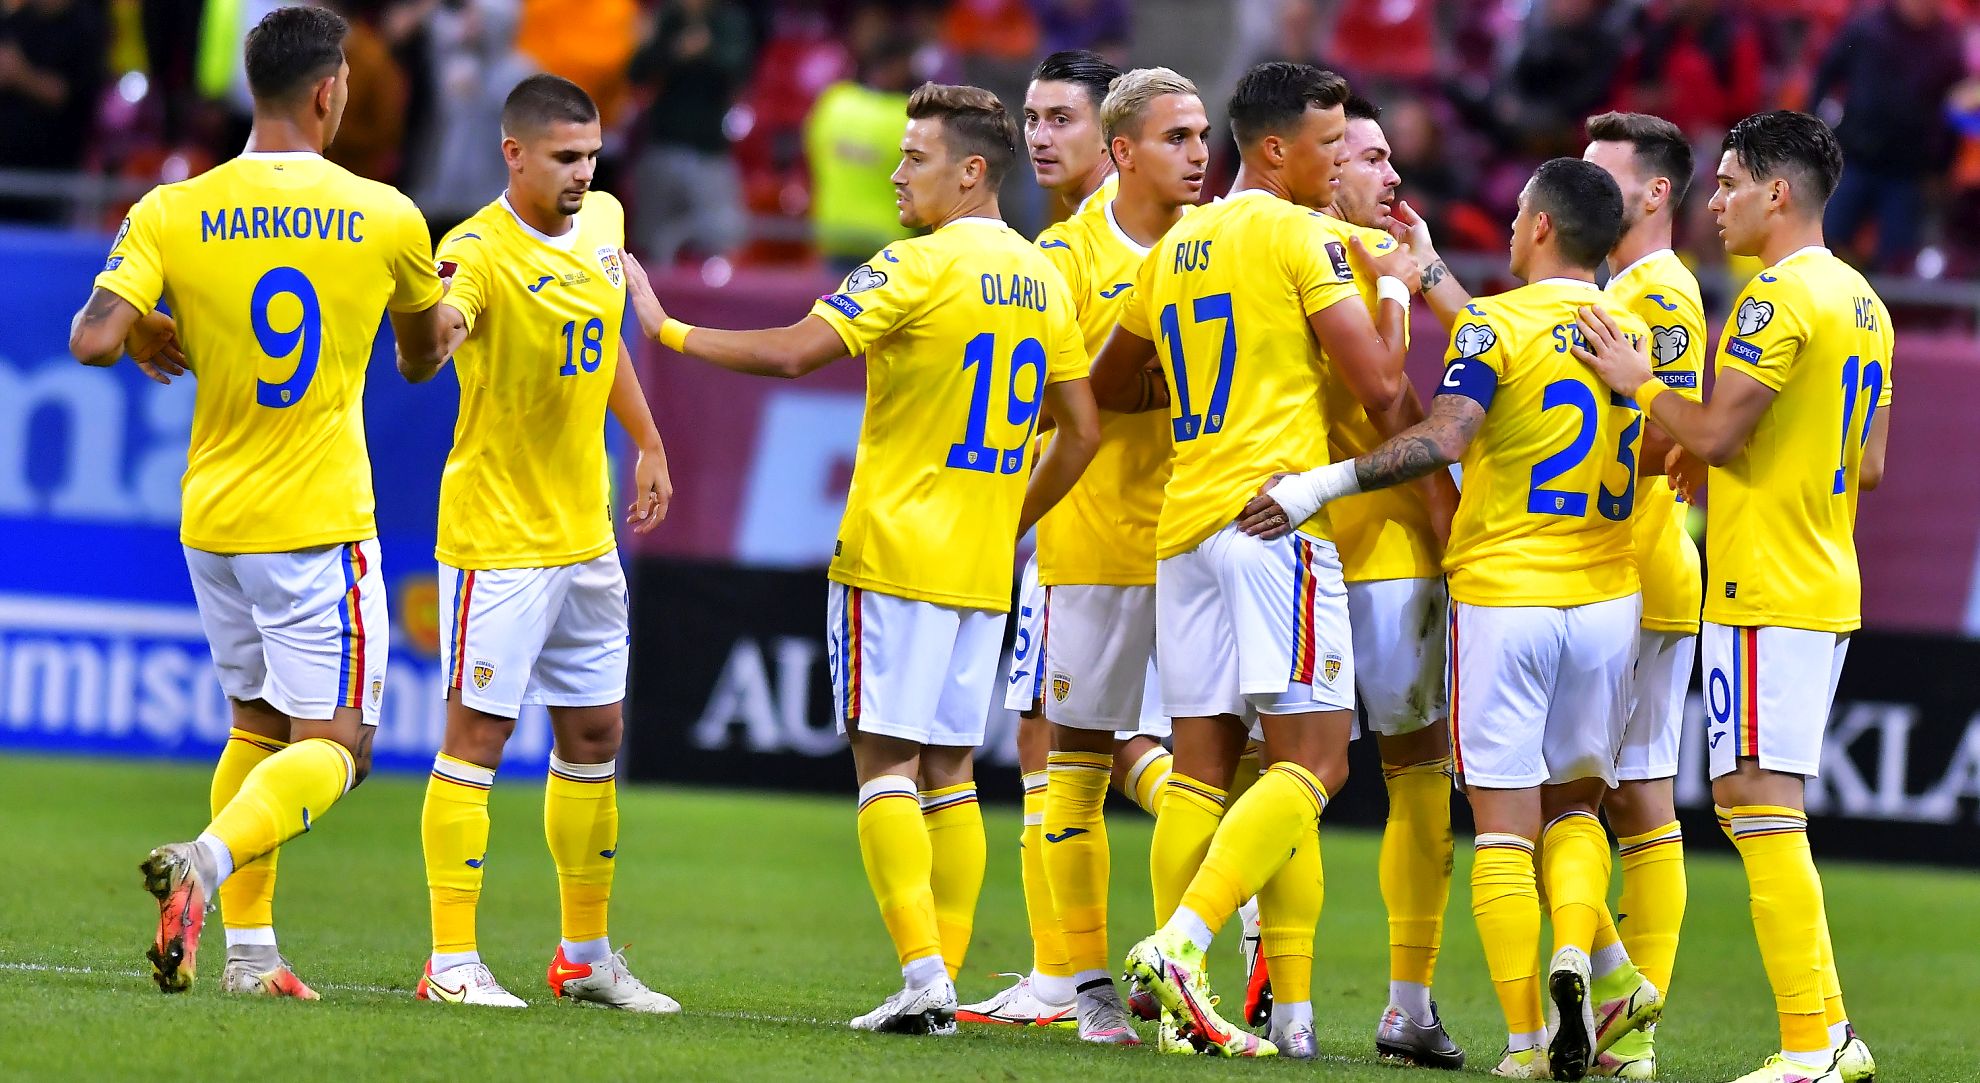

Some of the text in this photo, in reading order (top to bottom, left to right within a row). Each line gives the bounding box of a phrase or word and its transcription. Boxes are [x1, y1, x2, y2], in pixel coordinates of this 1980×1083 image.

[201, 206, 364, 243] MARKOVIC
[1174, 239, 1213, 275] RUS
[831, 294, 862, 316] RESPECT
[981, 273, 1047, 312] OLARU
[251, 266, 322, 409] 9
[560, 317, 604, 377] 18
[1732, 342, 1760, 361] RESPECT
[1160, 293, 1238, 442] 17
[1443, 362, 1466, 387] C
[1659, 374, 1697, 385] RESPECT
[946, 332, 1047, 475] 19
[1527, 378, 1642, 522] 23
